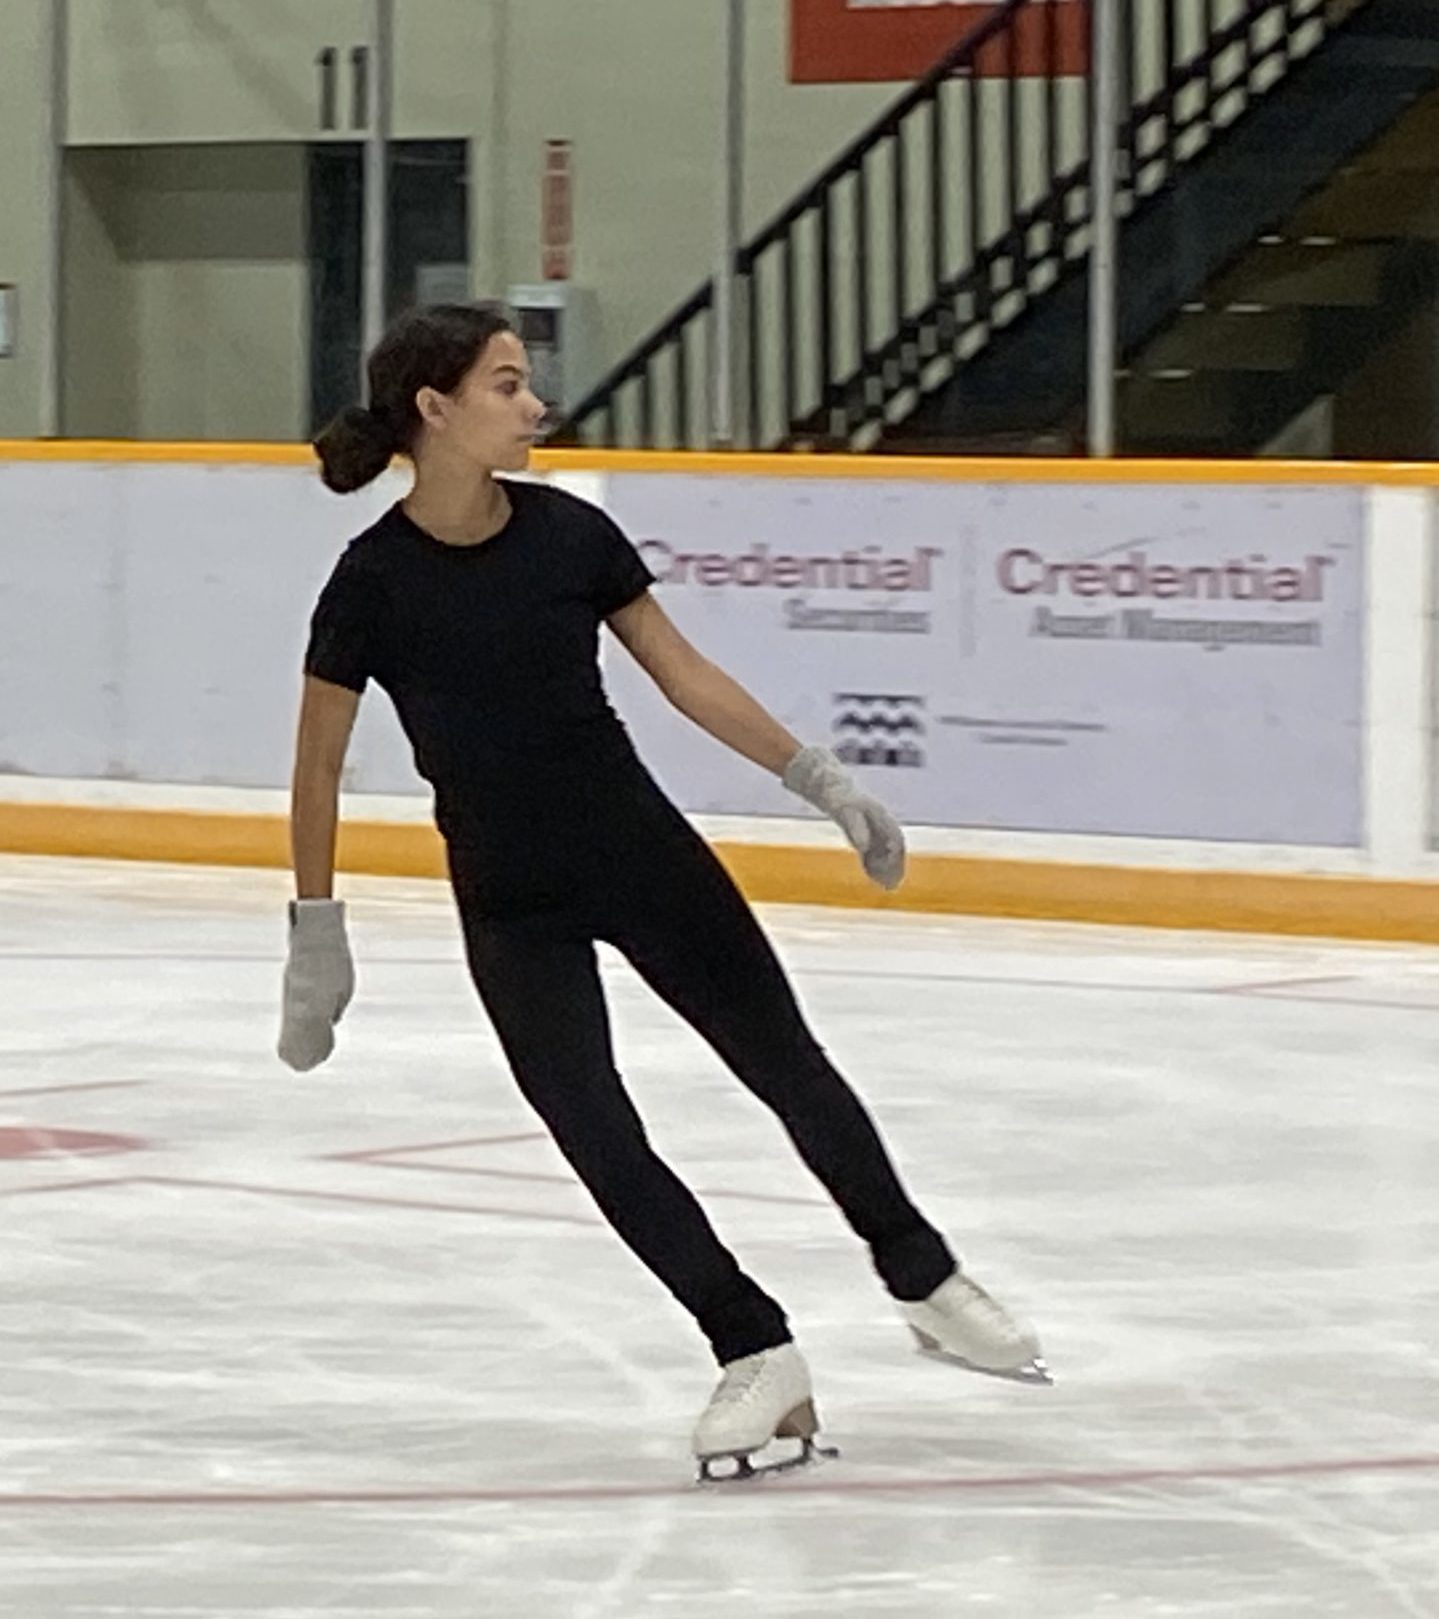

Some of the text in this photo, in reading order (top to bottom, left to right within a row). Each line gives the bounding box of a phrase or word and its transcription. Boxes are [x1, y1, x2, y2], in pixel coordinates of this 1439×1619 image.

[636, 541, 935, 593] Credential
[997, 548, 1327, 602] Credential
[1120, 609, 1323, 652] Management
